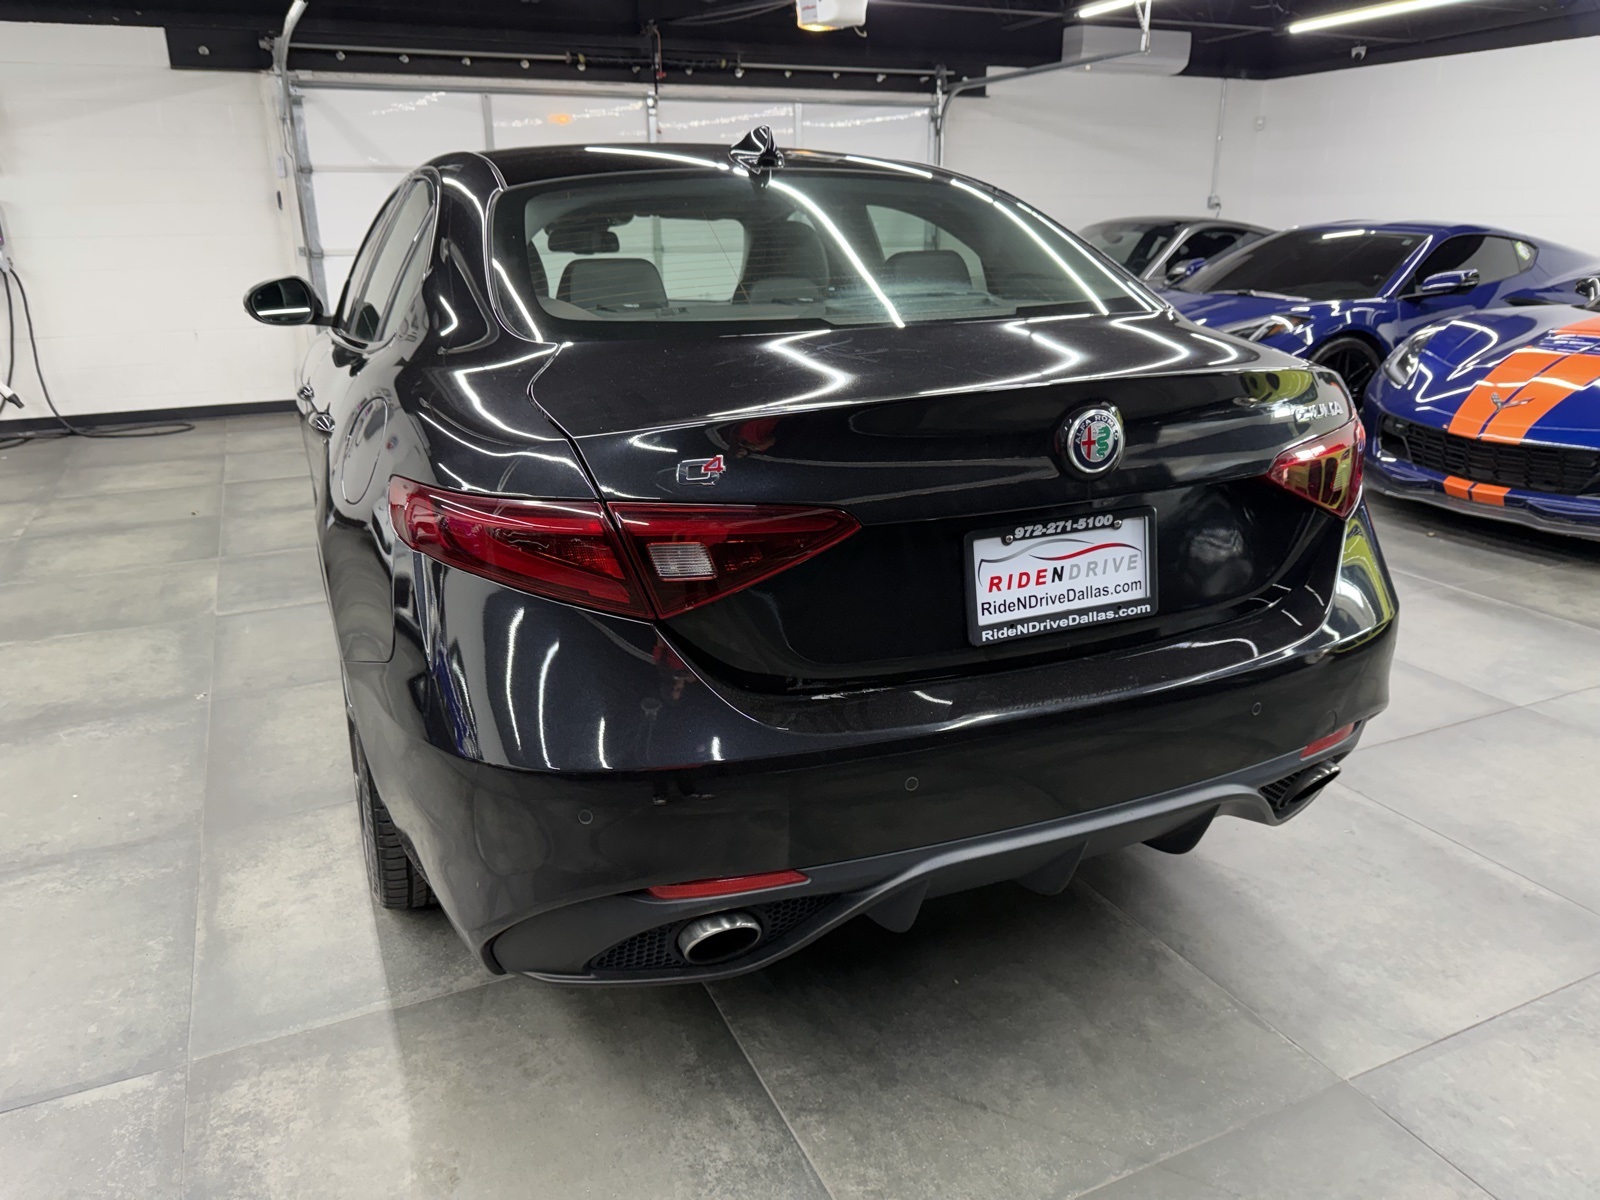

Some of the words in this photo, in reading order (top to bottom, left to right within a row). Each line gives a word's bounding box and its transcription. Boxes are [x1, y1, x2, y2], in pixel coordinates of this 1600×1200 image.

[1075, 418, 1092, 444] ALFA
[1014, 514, 1114, 539] 972-271-5100
[981, 579, 1142, 616] RideNDriveDallas.com
[982, 604, 1151, 642] RideNDriveDallas.com
